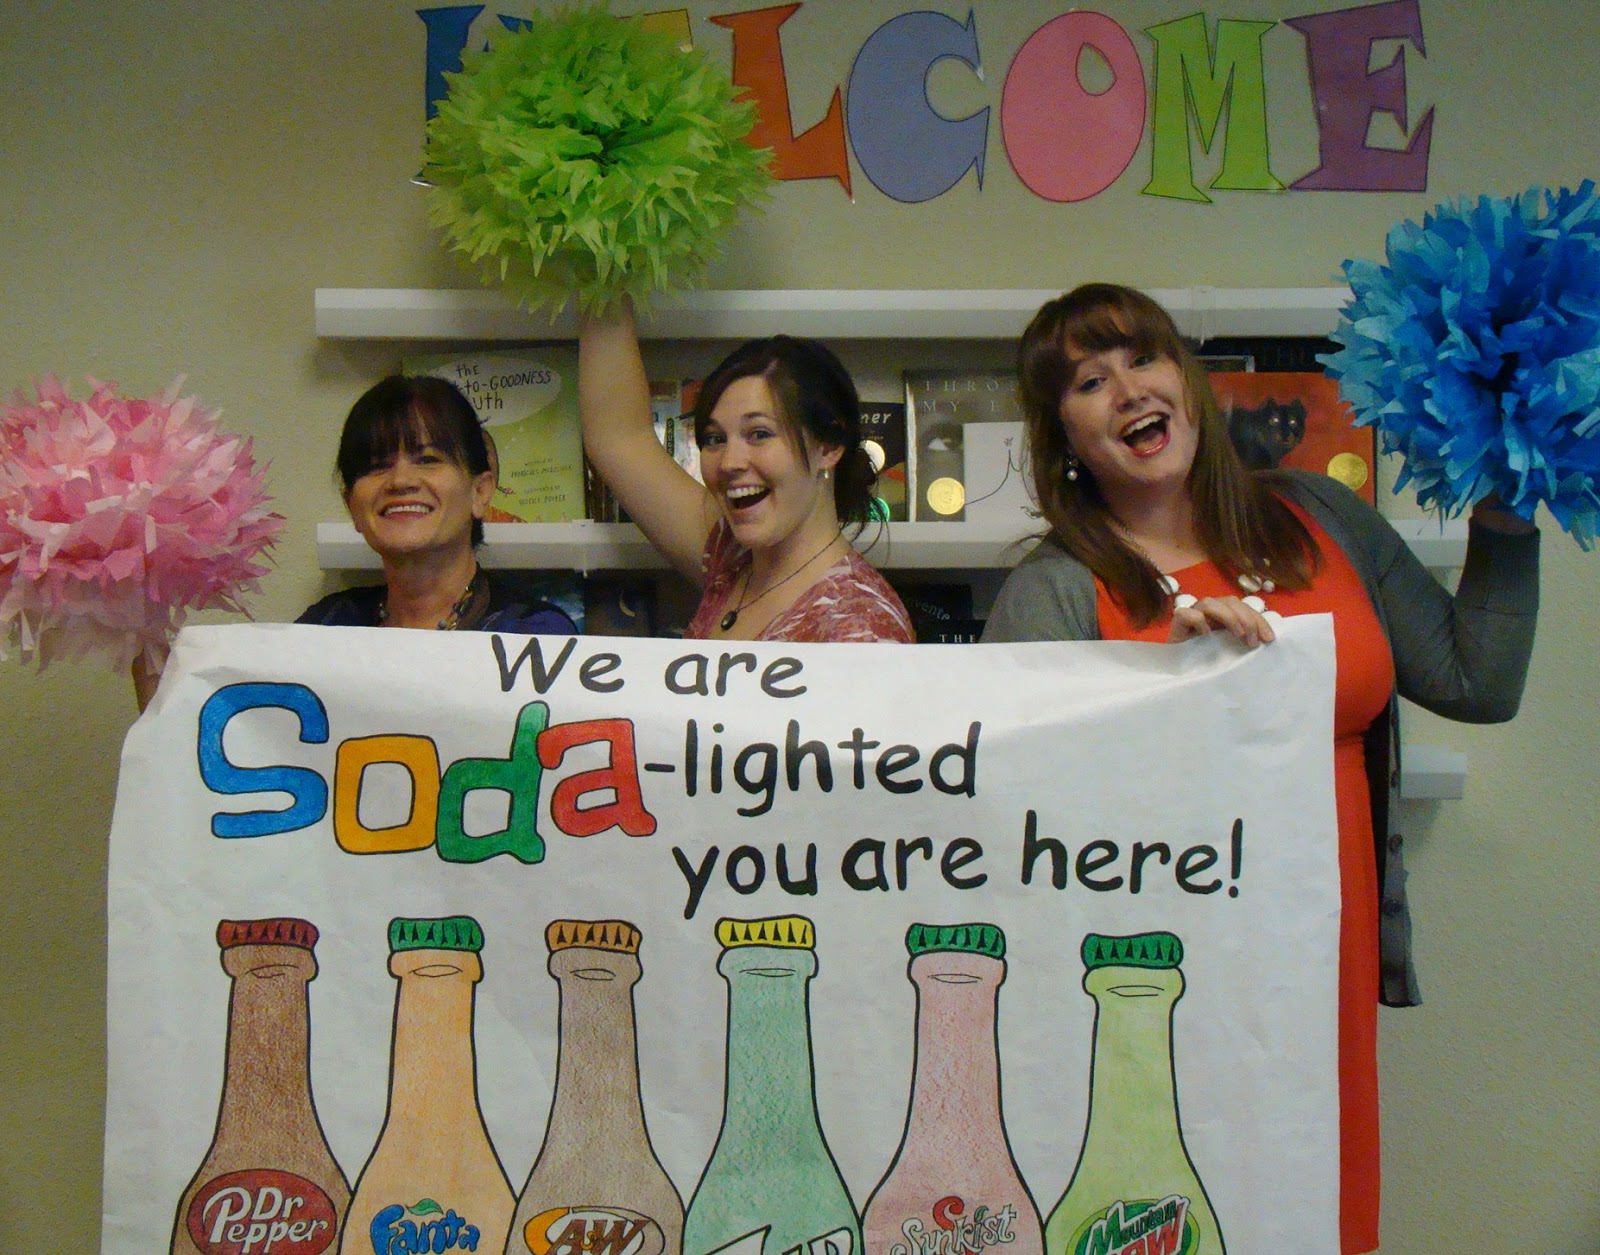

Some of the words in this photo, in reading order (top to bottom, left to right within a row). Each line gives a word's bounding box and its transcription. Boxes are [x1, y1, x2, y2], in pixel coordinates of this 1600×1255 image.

[417, 0, 1434, 204] LCOME
[472, 391, 504, 410] uth
[924, 379, 1017, 392] THRO
[860, 412, 892, 424] ner
[939, 633, 976, 643] THE
[491, 634, 624, 695] We
[664, 650, 808, 700] are
[671, 843, 818, 920] you
[841, 836, 988, 891] are
[1021, 809, 1244, 899] here!
[202, 1185, 329, 1254] Pepper
[251, 1186, 304, 1220] Dr
[1088, 1200, 1177, 1255] Mountain
[370, 1204, 480, 1255] Fanta
[890, 1203, 1017, 1255] Sunkist
